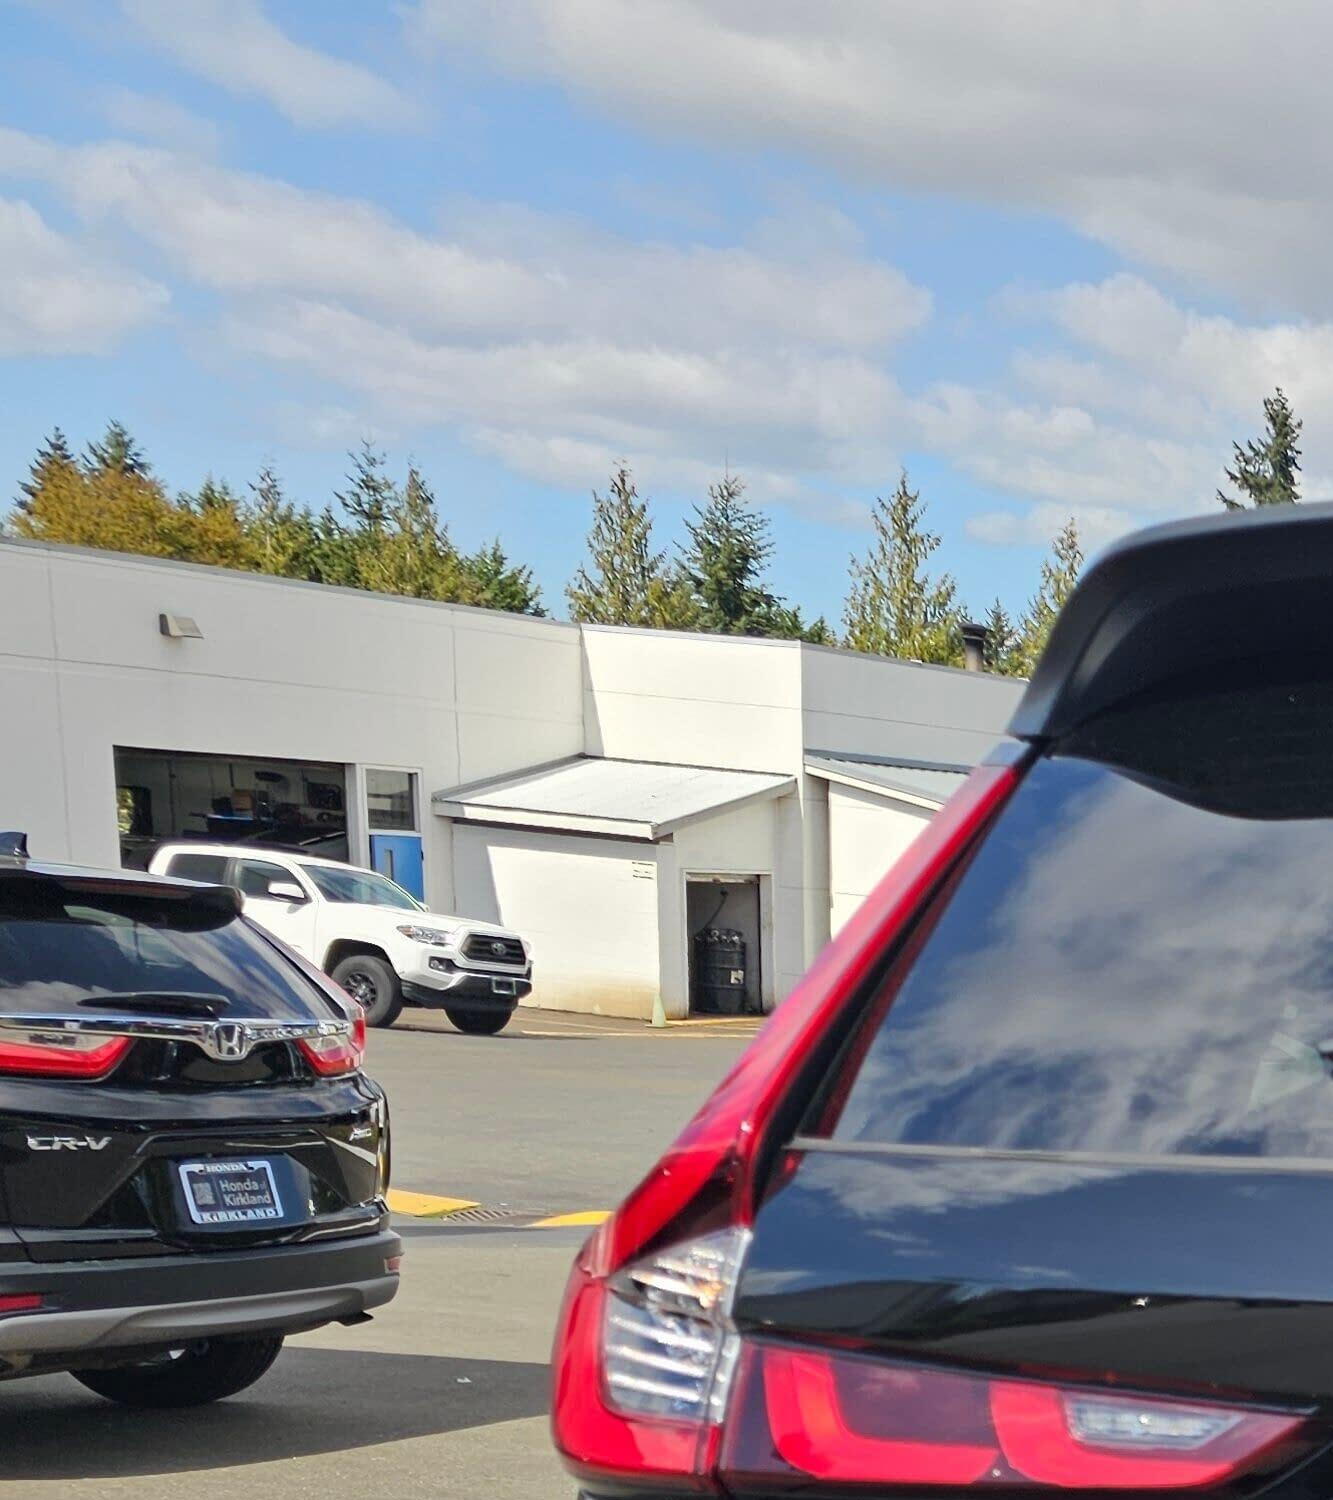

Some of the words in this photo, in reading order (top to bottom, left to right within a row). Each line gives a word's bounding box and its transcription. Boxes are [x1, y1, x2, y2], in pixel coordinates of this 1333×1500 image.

[26, 1135, 112, 1150] CR-V
[206, 1163, 249, 1173] HONDA
[219, 1178, 259, 1192] Honda
[223, 1191, 272, 1206] Kirkland
[201, 1208, 276, 1222] KIRKLAND
